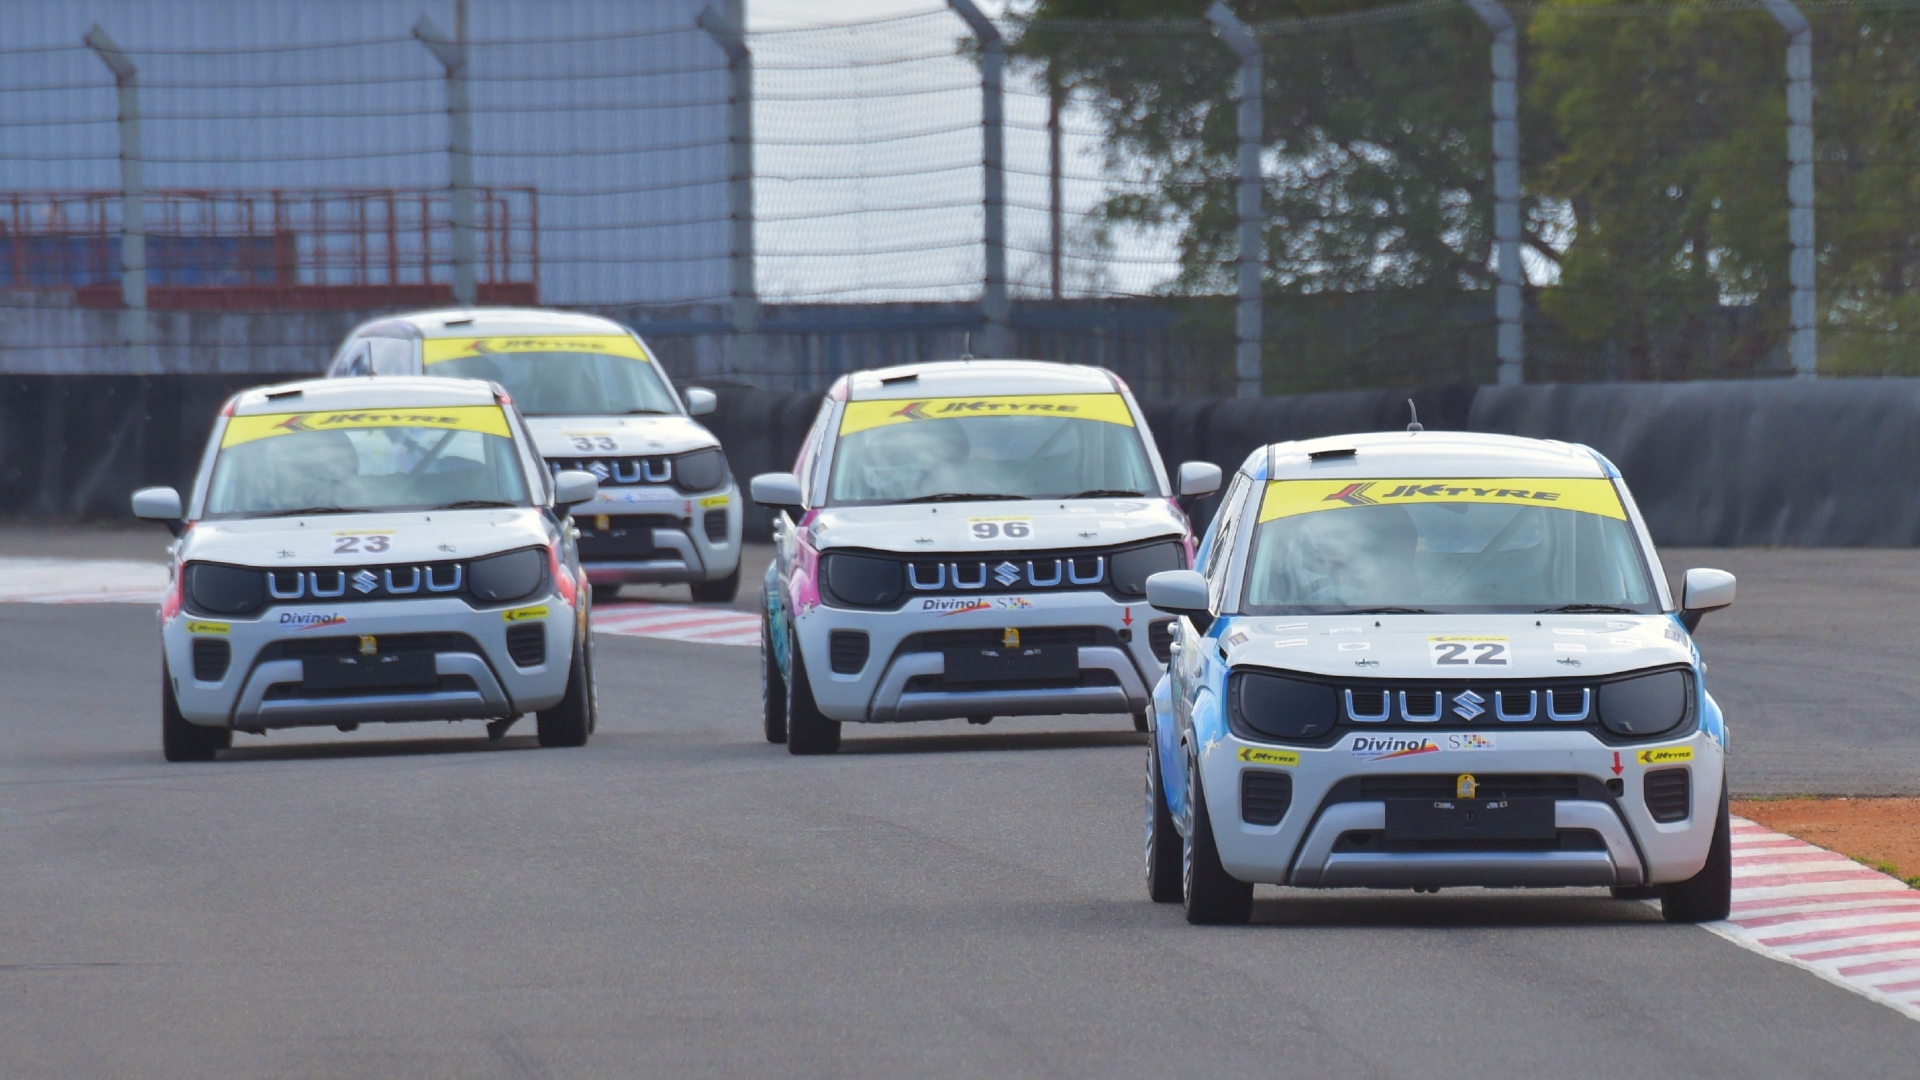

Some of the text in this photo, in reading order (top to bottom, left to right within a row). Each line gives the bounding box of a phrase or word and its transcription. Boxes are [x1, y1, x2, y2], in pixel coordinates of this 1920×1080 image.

[570, 436, 619, 452] 33
[972, 522, 1031, 539] 96
[333, 535, 391, 554] 23
[923, 598, 982, 610] Divinol
[279, 612, 338, 624] Divinol
[1434, 643, 1508, 665] 22
[1352, 737, 1428, 751] Divinol
